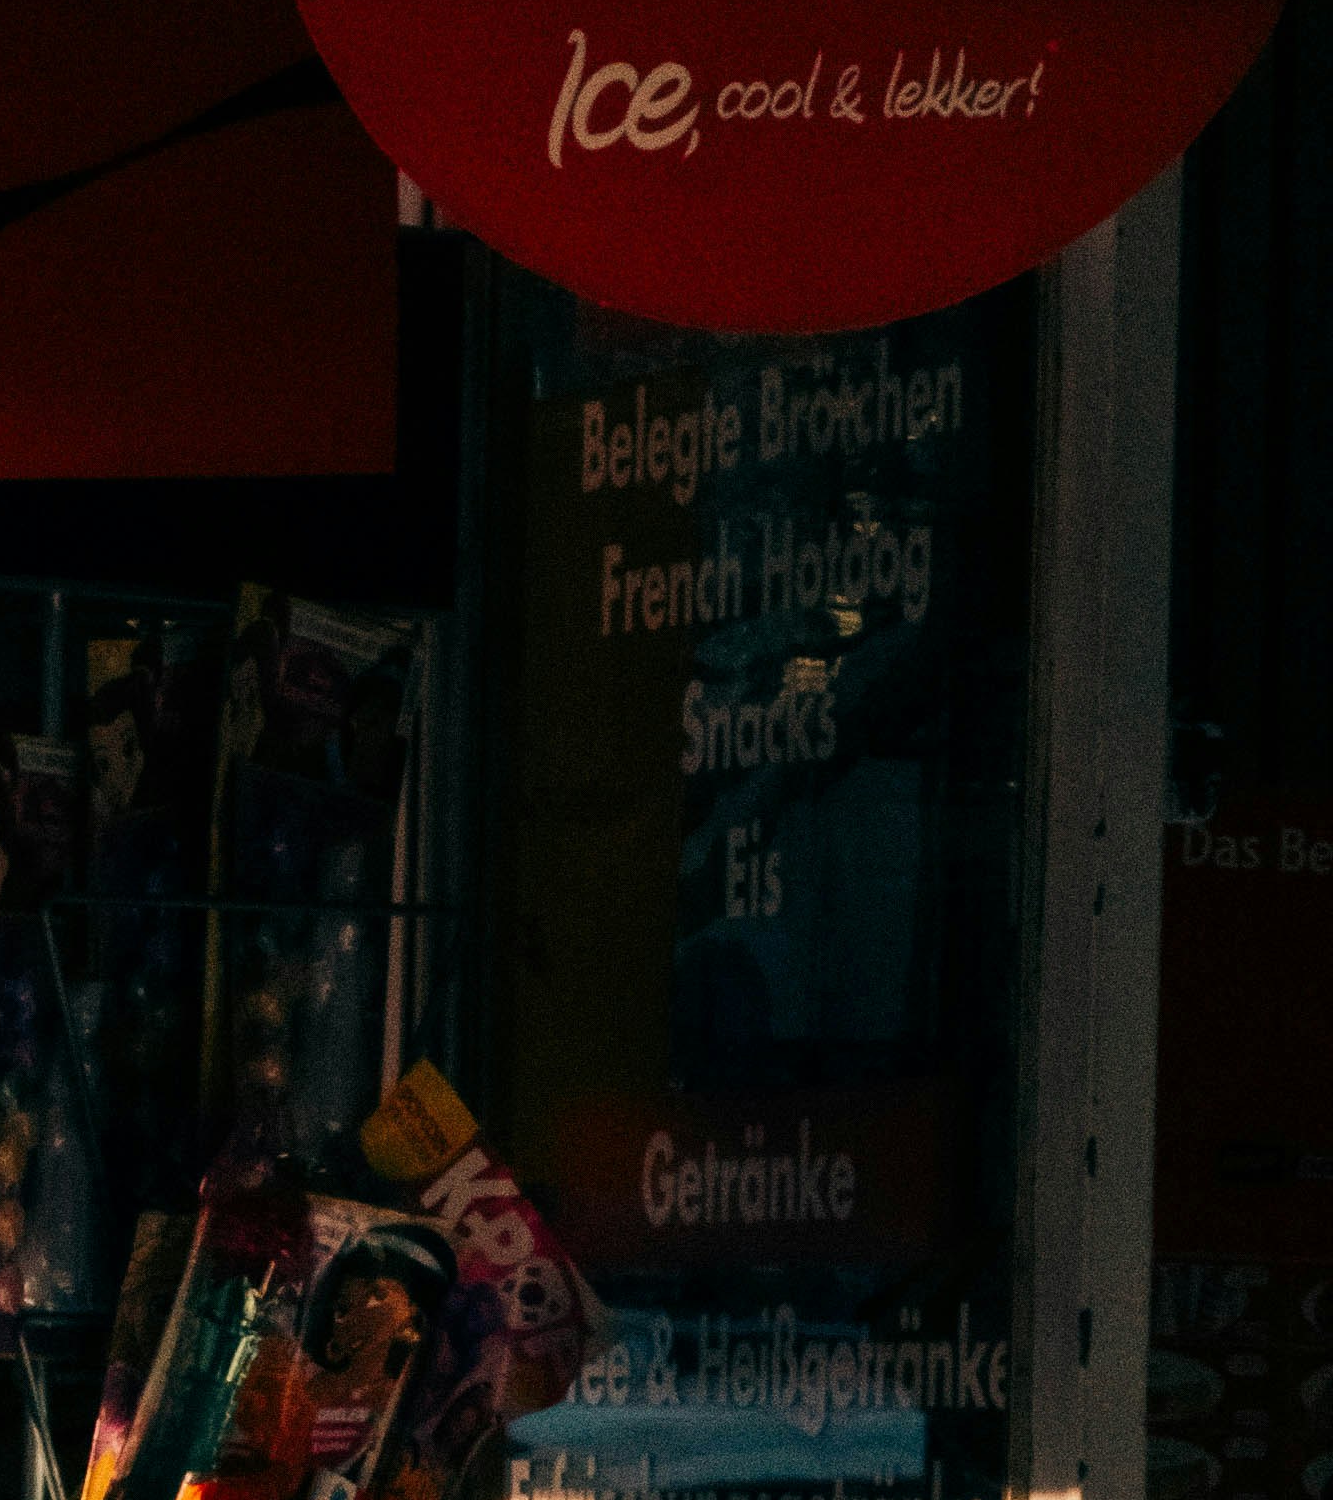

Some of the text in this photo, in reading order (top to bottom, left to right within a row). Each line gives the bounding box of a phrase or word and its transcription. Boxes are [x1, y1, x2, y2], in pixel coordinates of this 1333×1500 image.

[716, 46, 823, 121] cool
[832, 62, 864, 124] &
[882, 43, 1044, 120] lekker!
[581, 338, 963, 506] Belegte Brötchen
[600, 505, 932, 636] French Hotdog
[680, 668, 836, 776] Snacks
[724, 822, 783, 921] Eis
[1181, 828, 1263, 870] Das
[641, 1118, 859, 1229] Getränke
[646, 1315, 681, 1406] &
